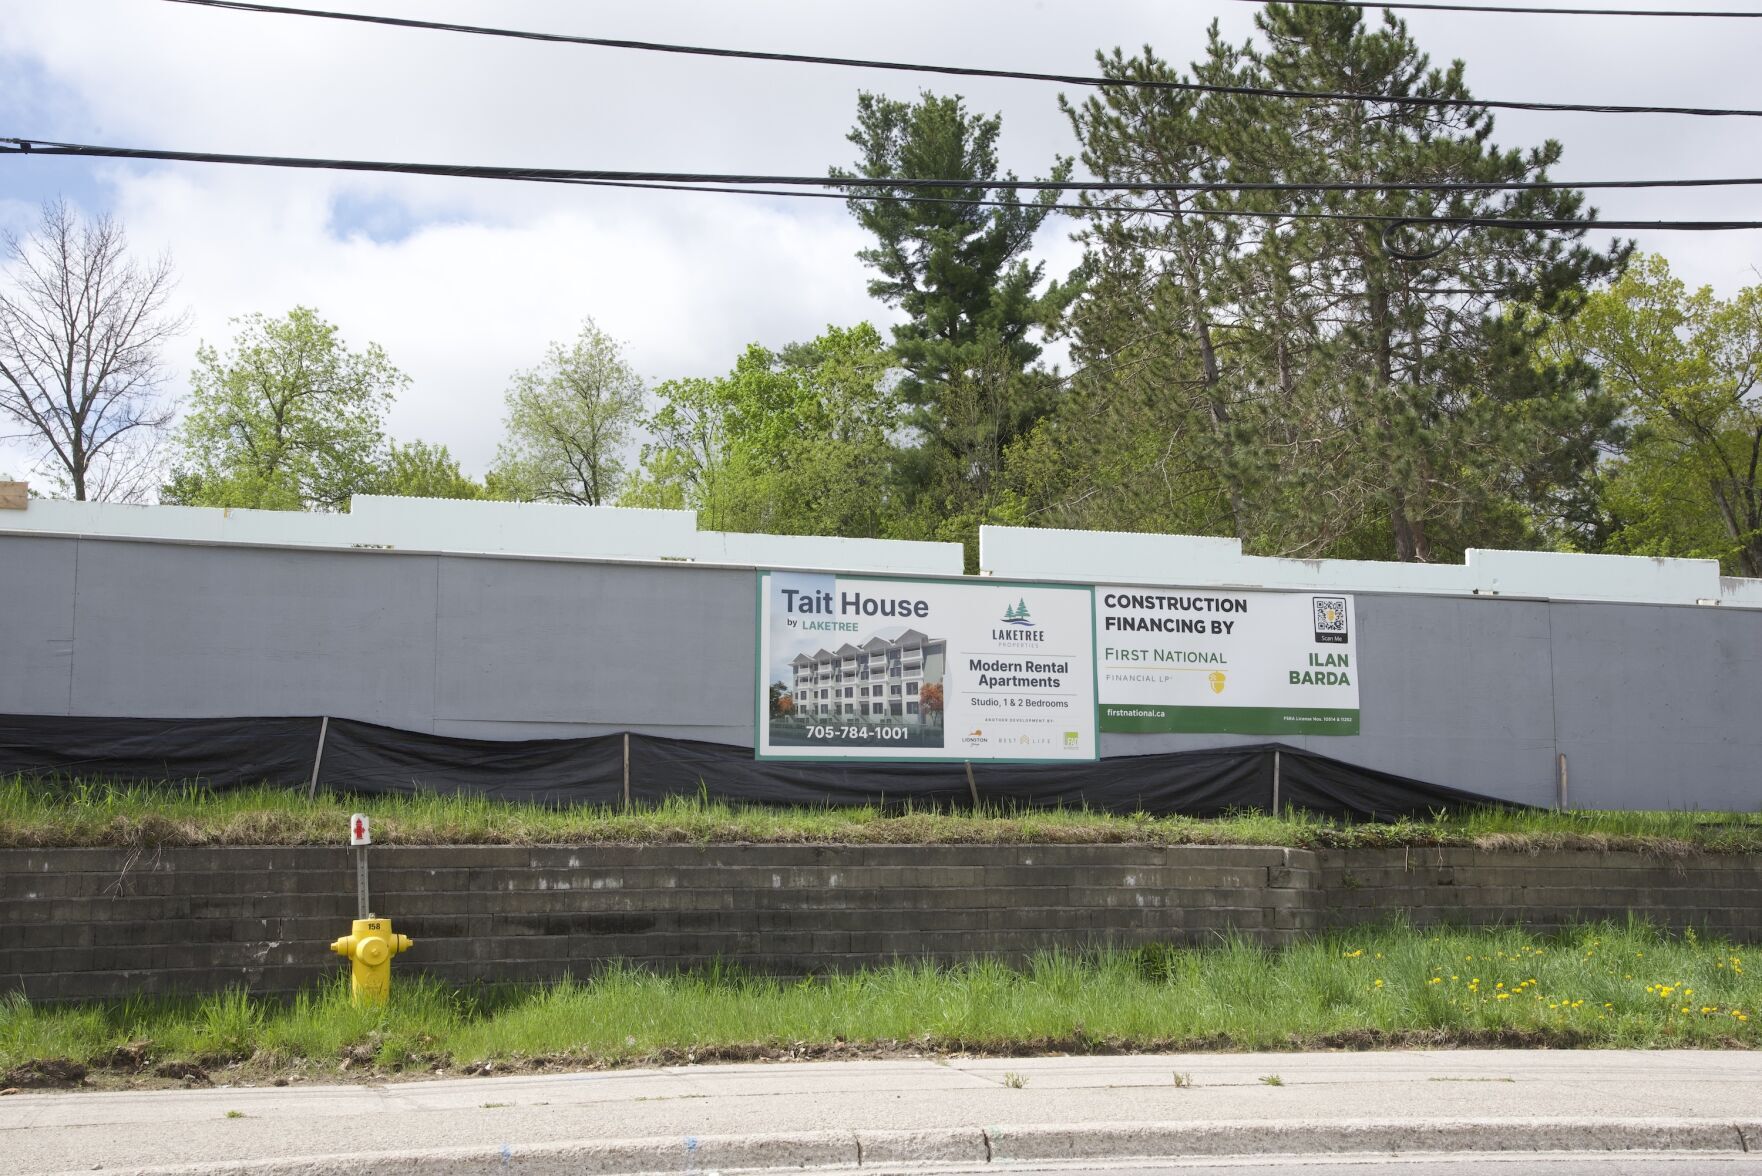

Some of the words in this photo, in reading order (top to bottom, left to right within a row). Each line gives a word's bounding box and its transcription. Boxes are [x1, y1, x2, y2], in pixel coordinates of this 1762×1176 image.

[781, 589, 833, 615] Tait
[841, 592, 929, 618] House
[1104, 594, 1248, 613] CONSTRUCTION
[787, 618, 798, 628] by
[802, 620, 859, 632] LAKETREE
[1105, 616, 1206, 634] FINANCING
[1211, 620, 1235, 635] BY
[992, 629, 1045, 642] LAKETREE
[969, 659, 1023, 673] Modern
[1025, 661, 1069, 674] Rental
[1309, 652, 1349, 668] ILAN
[978, 674, 1061, 689] Apartments
[1106, 674, 1156, 682] FINANCIAL
[1289, 670, 1351, 686] BARDA
[971, 697, 1002, 708] Studio,
[1003, 698, 1008, 706] 1
[1009, 699, 1016, 707] &
[1018, 699, 1024, 707] 2
[1025, 698, 1069, 708] Bedrooms
[1107, 708, 1165, 718] firstnational.ca
[806, 725, 908, 740] 705-784-1001
